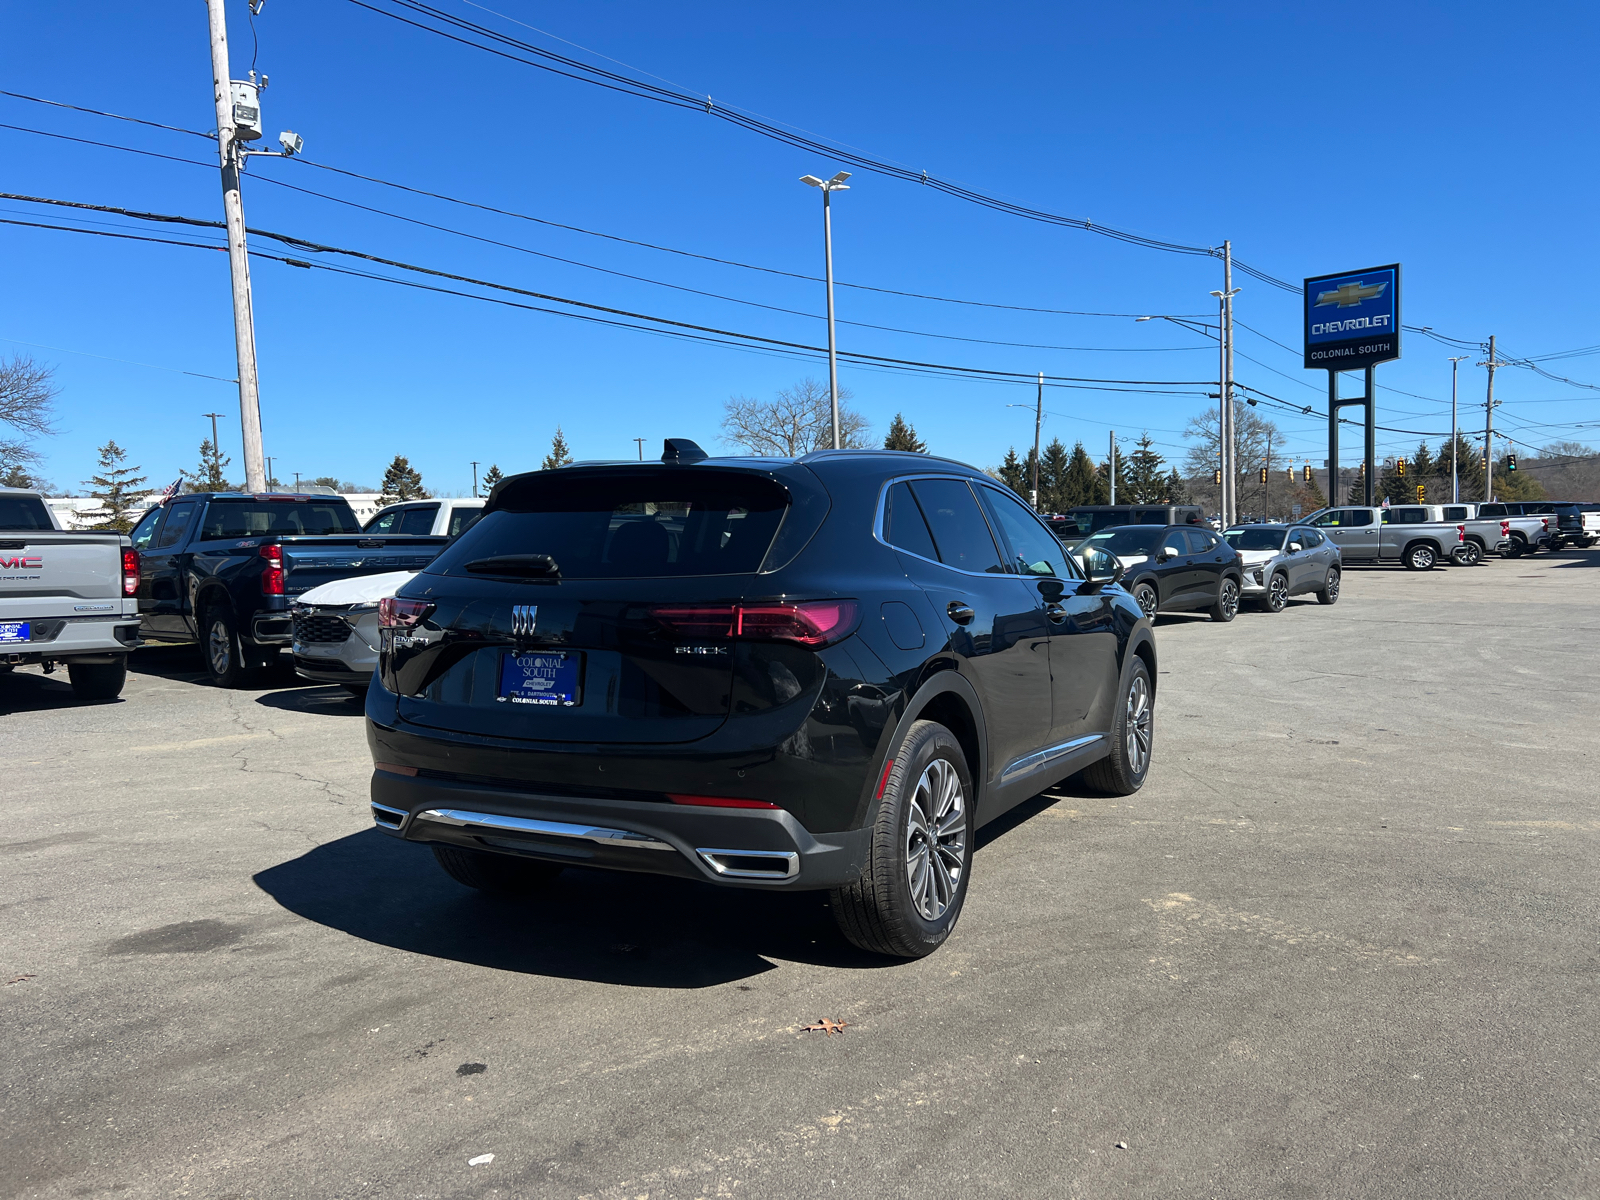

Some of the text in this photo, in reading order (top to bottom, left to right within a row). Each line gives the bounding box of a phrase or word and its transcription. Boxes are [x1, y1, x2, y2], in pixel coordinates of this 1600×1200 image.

[1311, 314, 1391, 335] CHEVROLET
[1310, 343, 1390, 360] COLONIAL SOUTH
[0, 556, 42, 569] MC
[297, 557, 433, 567] CHEVROLE
[674, 646, 728, 655] BUICK
[516, 656, 565, 669] COLONIAL
[522, 667, 557, 678] SOUTH
[512, 697, 539, 705] COLONIAL
